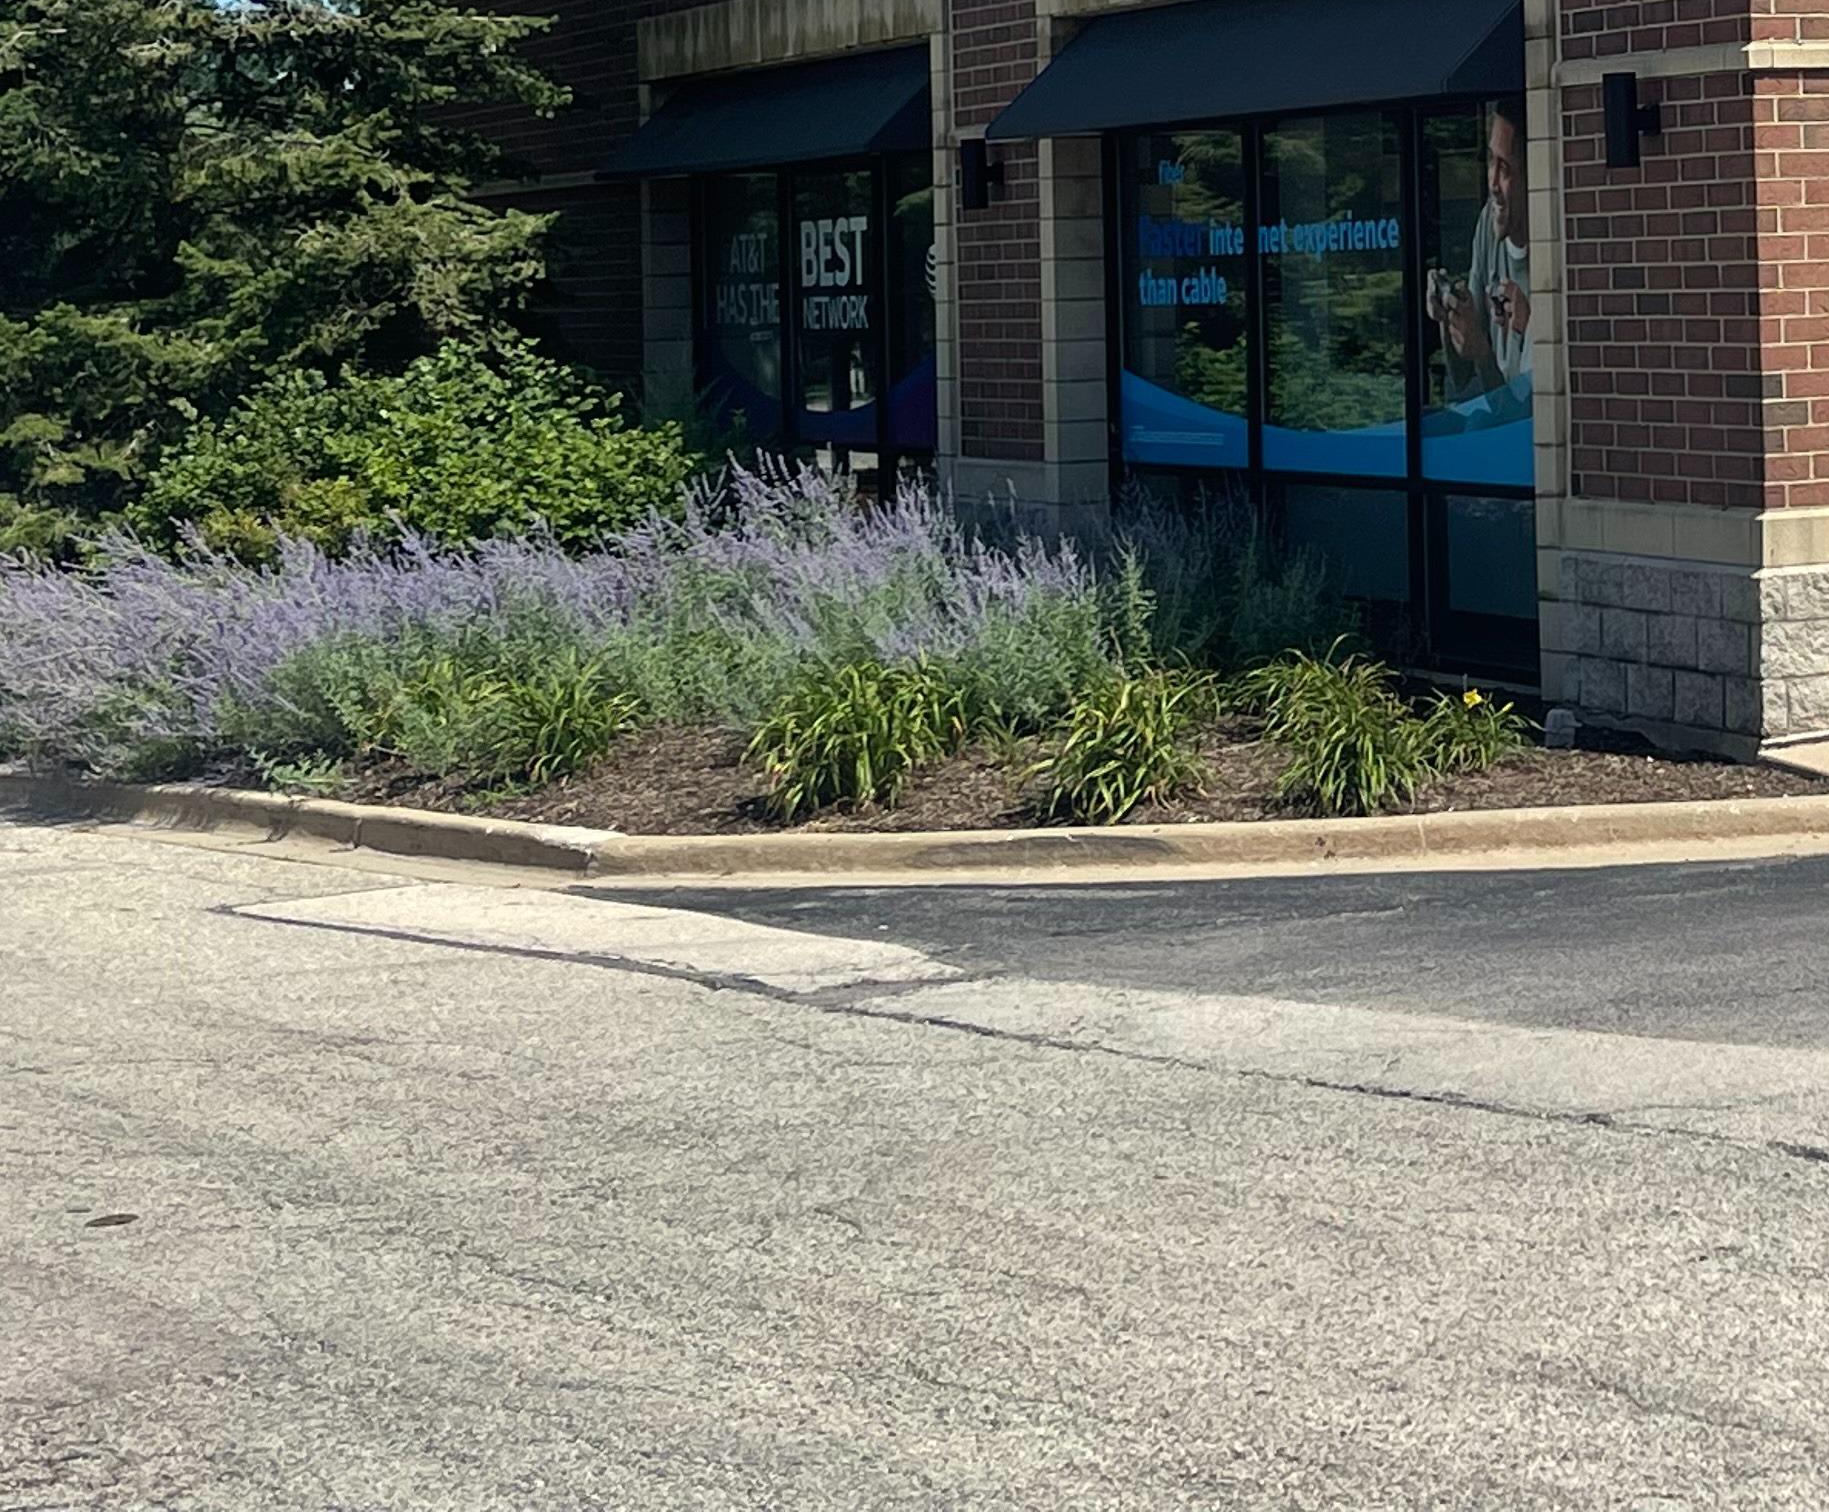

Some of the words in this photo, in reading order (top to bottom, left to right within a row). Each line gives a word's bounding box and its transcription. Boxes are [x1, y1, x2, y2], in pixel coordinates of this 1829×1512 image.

[728, 232, 768, 275] AT&T
[800, 215, 868, 287] BEST
[1209, 215, 1288, 256] intenet
[1292, 209, 1400, 263] experience
[715, 283, 748, 325] HAS
[749, 282, 780, 326] THE
[1138, 267, 1178, 306] than
[1181, 265, 1228, 305] cable
[803, 295, 869, 329] NETWORK
